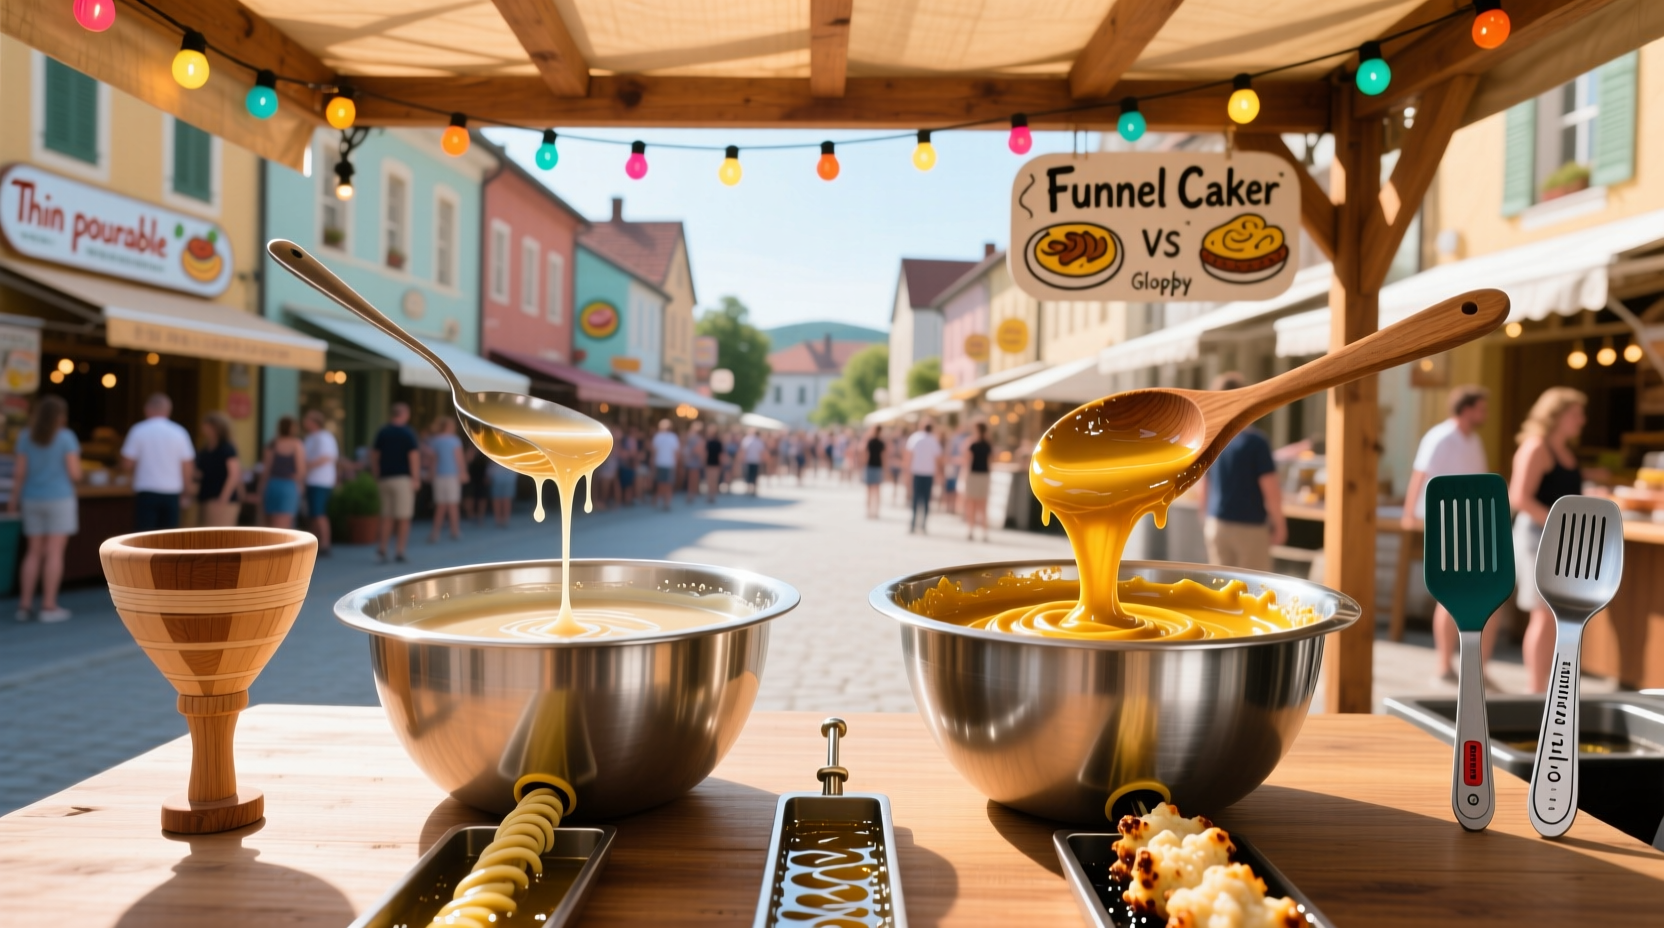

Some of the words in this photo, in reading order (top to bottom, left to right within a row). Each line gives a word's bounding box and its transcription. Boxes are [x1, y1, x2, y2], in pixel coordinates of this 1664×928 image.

[11, 178, 65, 232] Thin
[71, 212, 168, 258] pourable
[1046, 165, 1167, 213] Funnel
[1177, 165, 1281, 209] Caker
